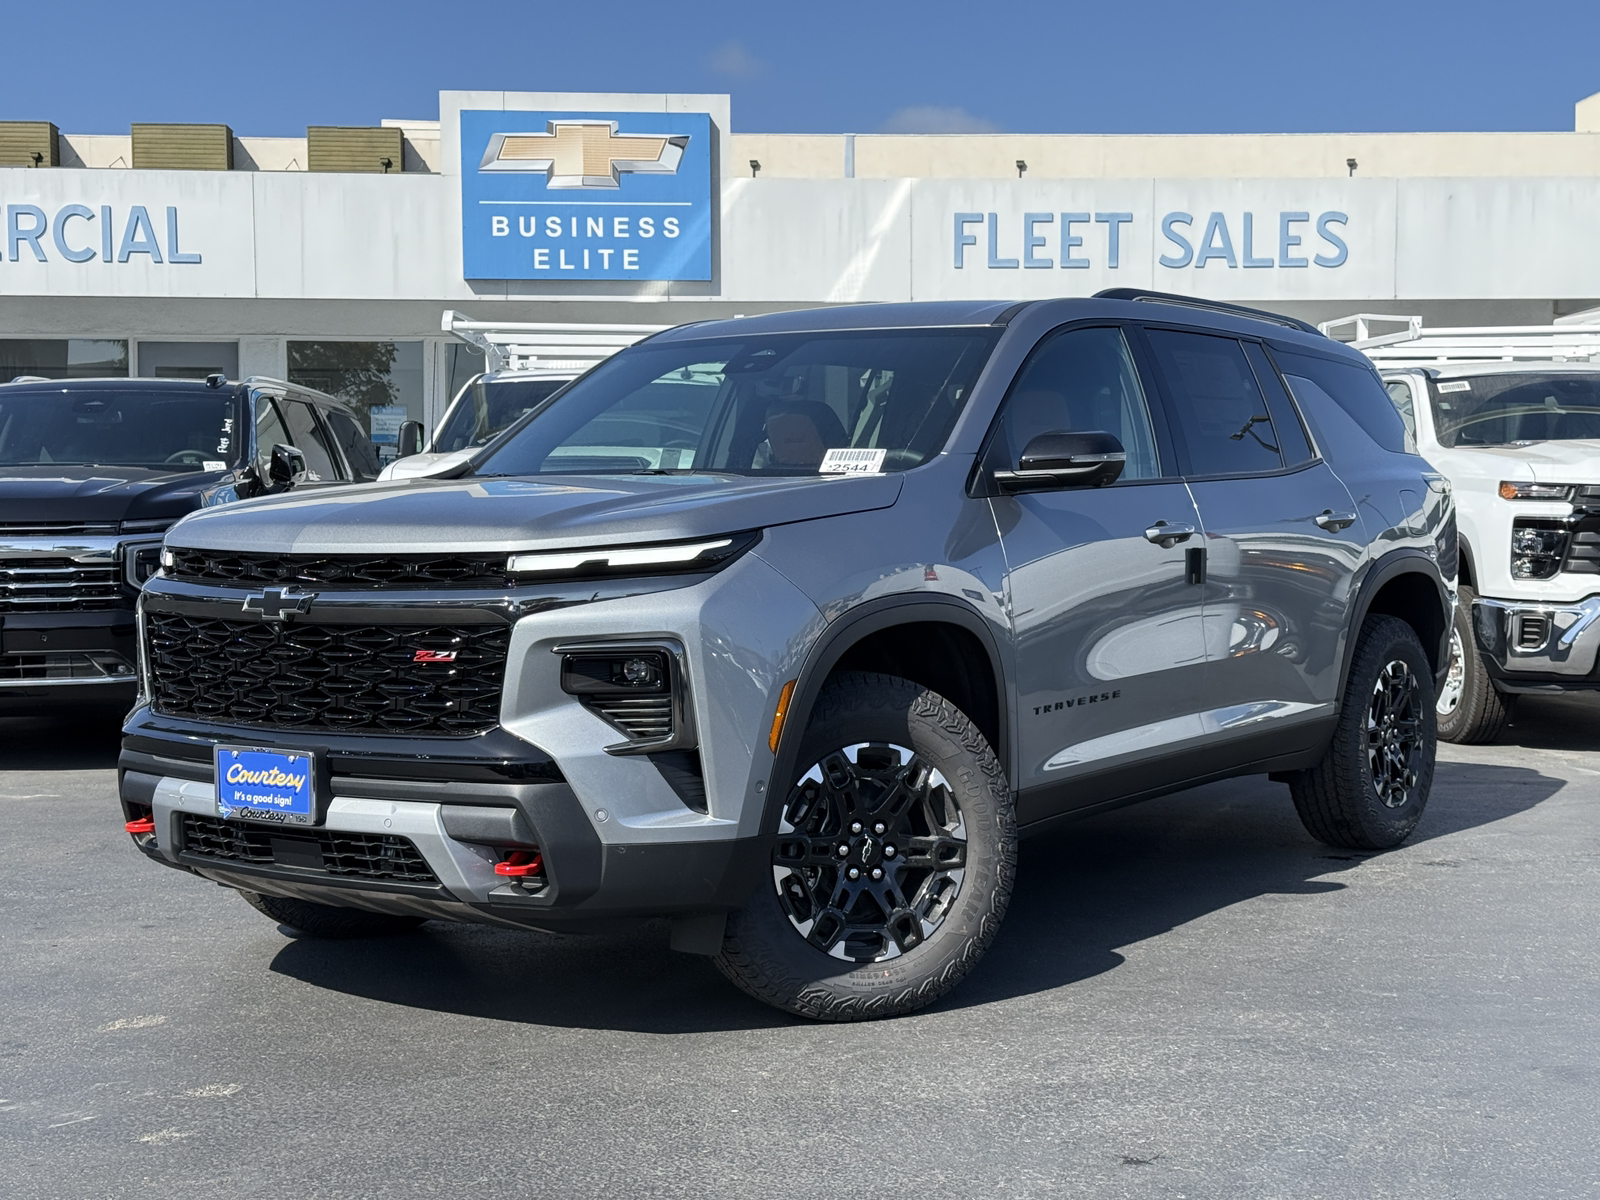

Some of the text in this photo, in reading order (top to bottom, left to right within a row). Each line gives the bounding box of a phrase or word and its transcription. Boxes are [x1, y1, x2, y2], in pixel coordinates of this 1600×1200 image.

[0, 204, 202, 264] RCIAL
[491, 216, 680, 238] BUSINESS
[953, 211, 1349, 269] FLEET SALES
[533, 248, 640, 270] ELITE
[413, 650, 457, 662] Z71
[1033, 689, 1121, 715] TRAVERSE
[227, 763, 306, 793] Courtesy
[234, 790, 246, 801] It's
[253, 793, 273, 805] good
[273, 794, 292, 807] sign!
[240, 806, 287, 823] Courtesy
